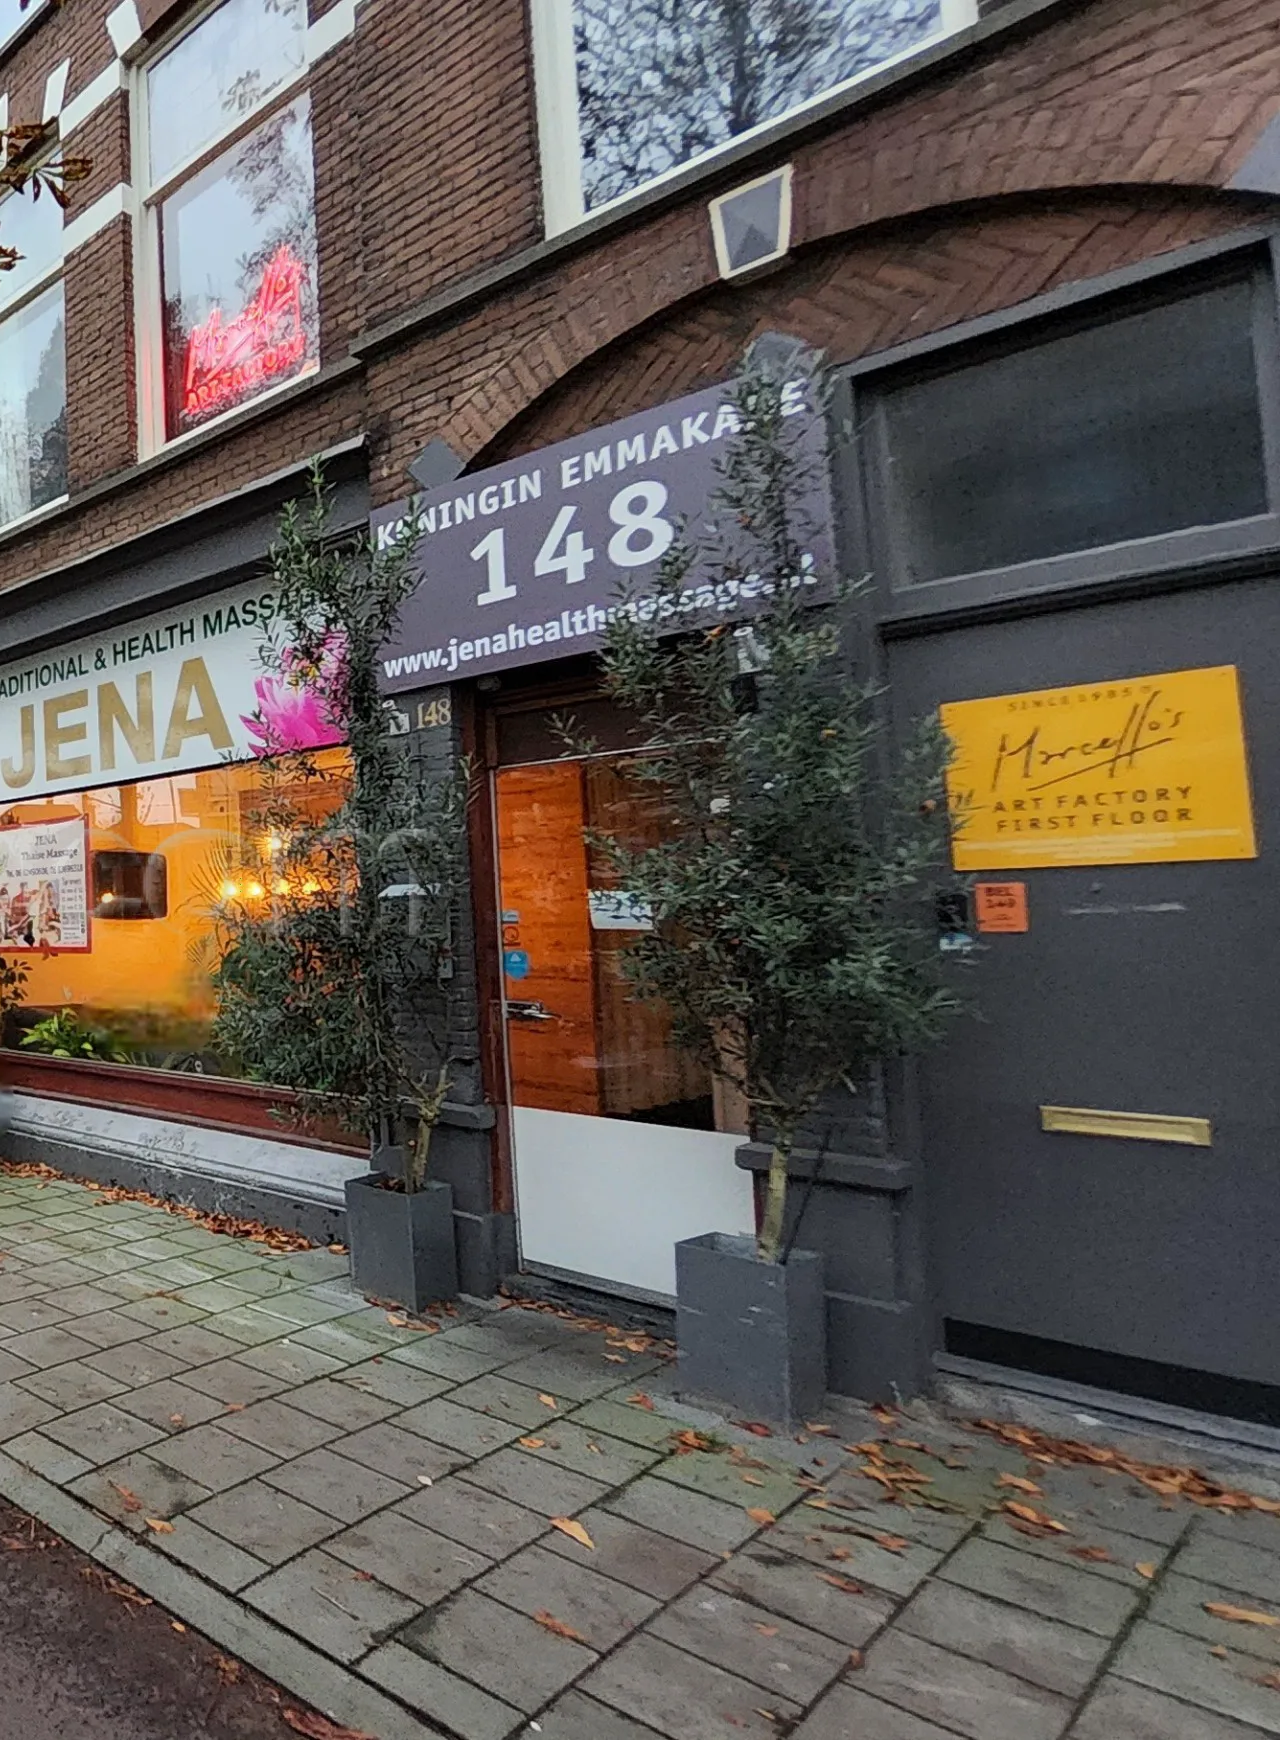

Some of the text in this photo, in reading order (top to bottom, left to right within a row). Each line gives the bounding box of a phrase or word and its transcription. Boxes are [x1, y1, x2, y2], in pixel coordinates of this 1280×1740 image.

[561, 378, 807, 490] EMMAKAE
[469, 480, 676, 606] 148
[94, 648, 107, 671] &
[113, 618, 195, 667] HEALTH
[1, 656, 234, 789] JENA
[416, 698, 452, 729] 148
[991, 690, 1184, 792] Marcello's
[993, 786, 1193, 813] ART FACTORY
[996, 808, 1194, 833] FIRST FLOOR
